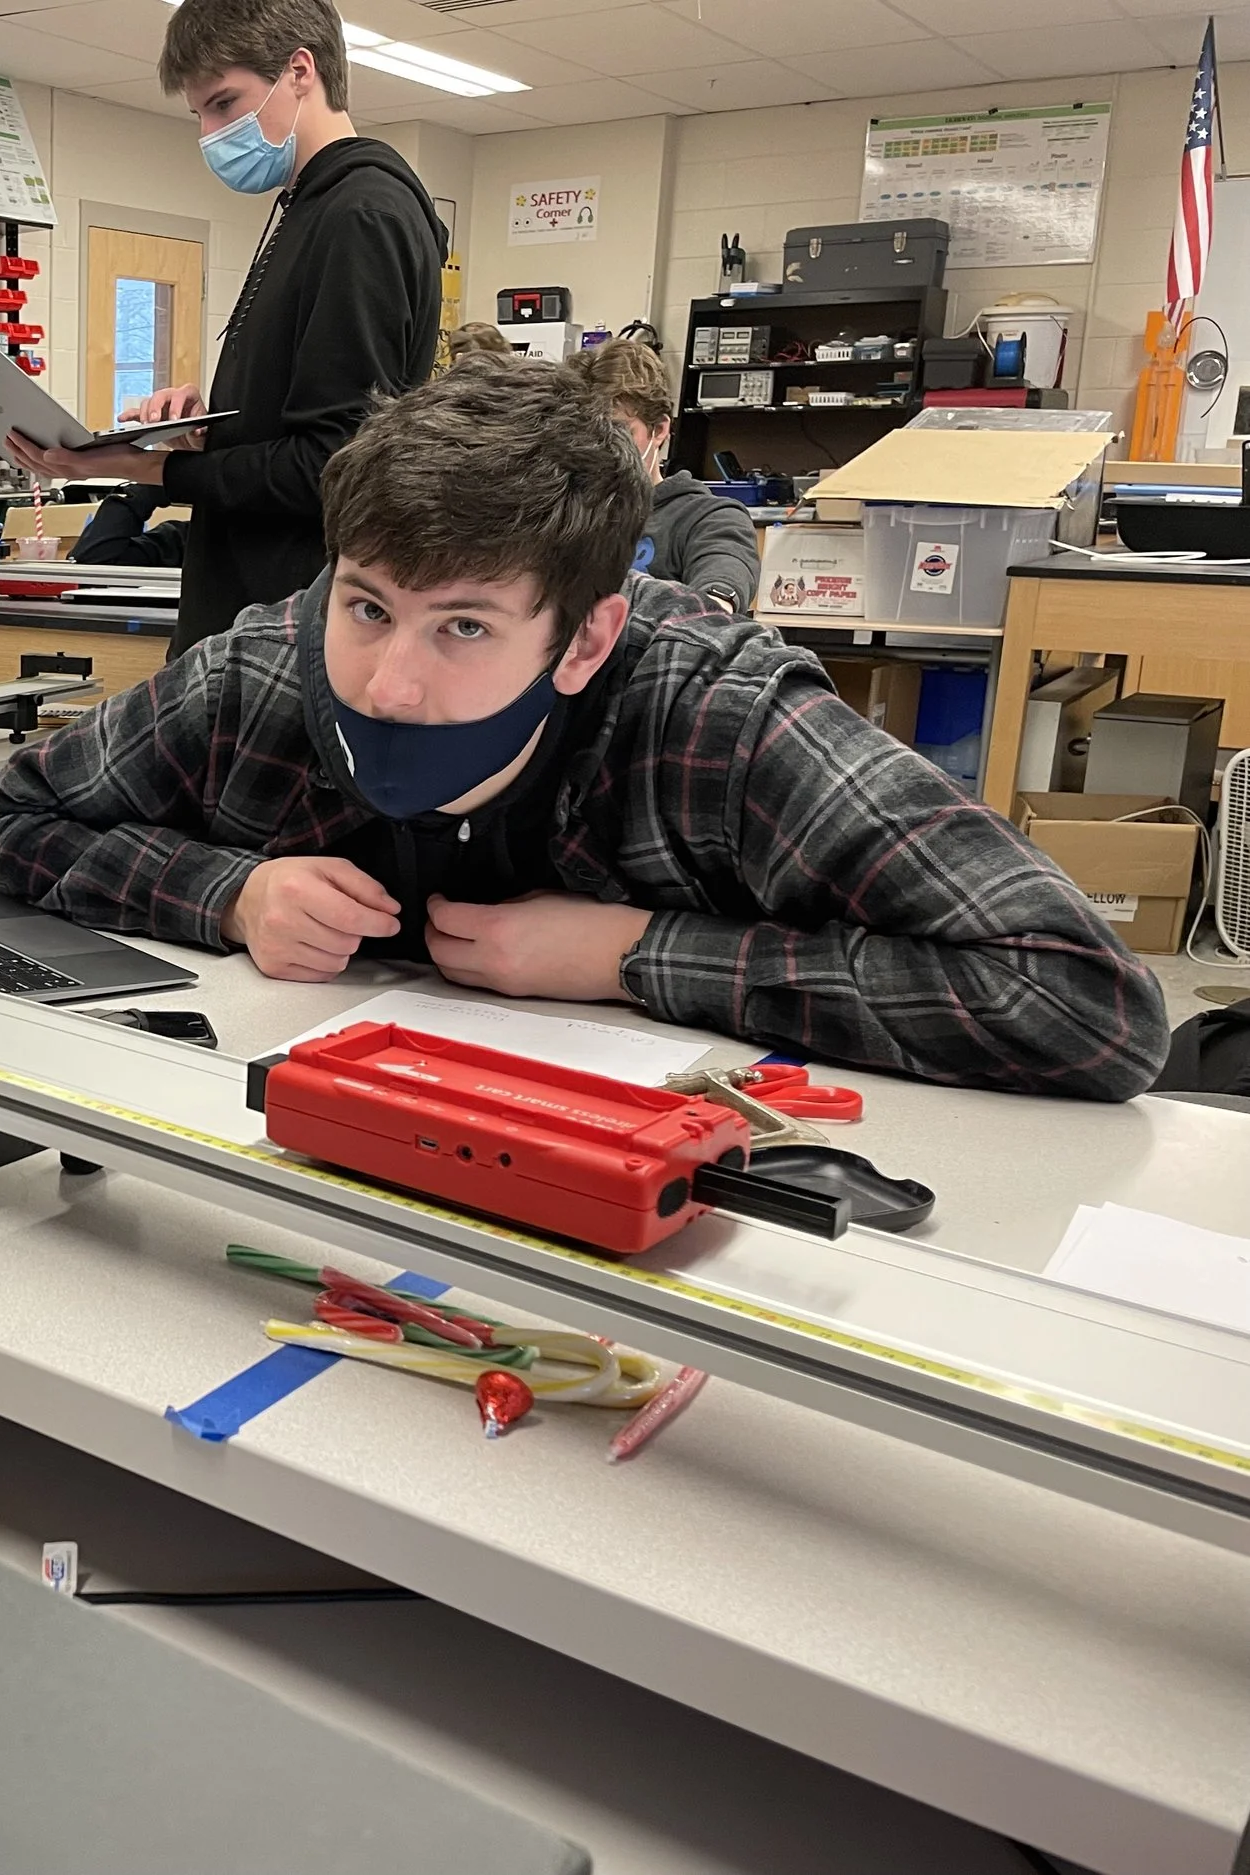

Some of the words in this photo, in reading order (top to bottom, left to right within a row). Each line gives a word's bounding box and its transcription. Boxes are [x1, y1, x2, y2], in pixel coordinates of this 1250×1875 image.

[530, 190, 582, 207] SAFETY
[536, 208, 572, 219] Corner
[529, 350, 544, 358] AID
[1086, 892, 1126, 904] LLOW
[474, 1084, 513, 1098] cart
[513, 1093, 570, 1112] smart
